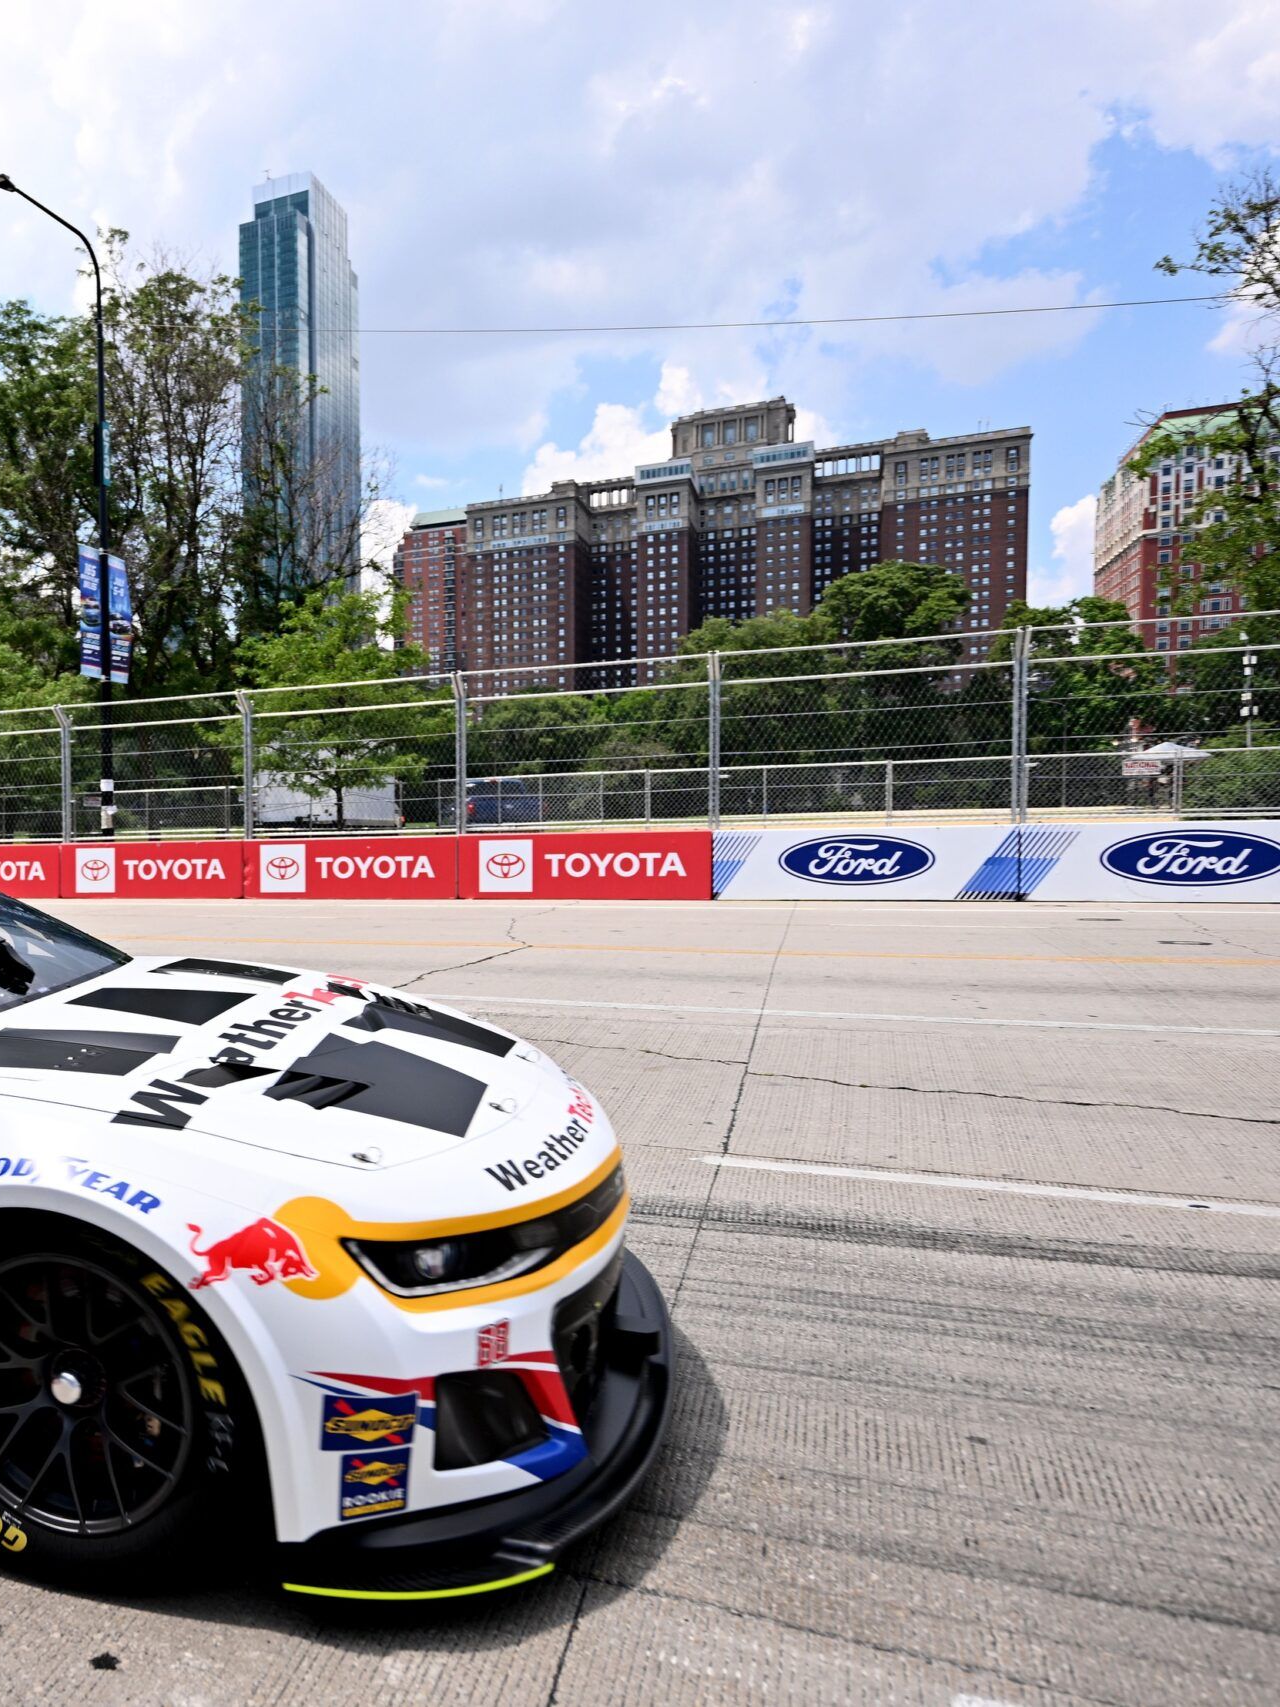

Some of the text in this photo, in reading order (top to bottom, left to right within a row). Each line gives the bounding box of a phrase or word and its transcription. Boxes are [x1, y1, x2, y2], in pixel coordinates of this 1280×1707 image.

[123, 858, 226, 880] TOYOTA
[315, 855, 435, 879] TOYOTA
[544, 852, 687, 878] TOYOTA
[808, 842, 900, 876] Ford
[1135, 838, 1249, 875] Ford
[139, 1271, 227, 1407] EAGLE
[476, 1317, 510, 1369] 88
[326, 1415, 416, 1434] SUNOCO
[342, 1487, 406, 1508] ROOKIE
